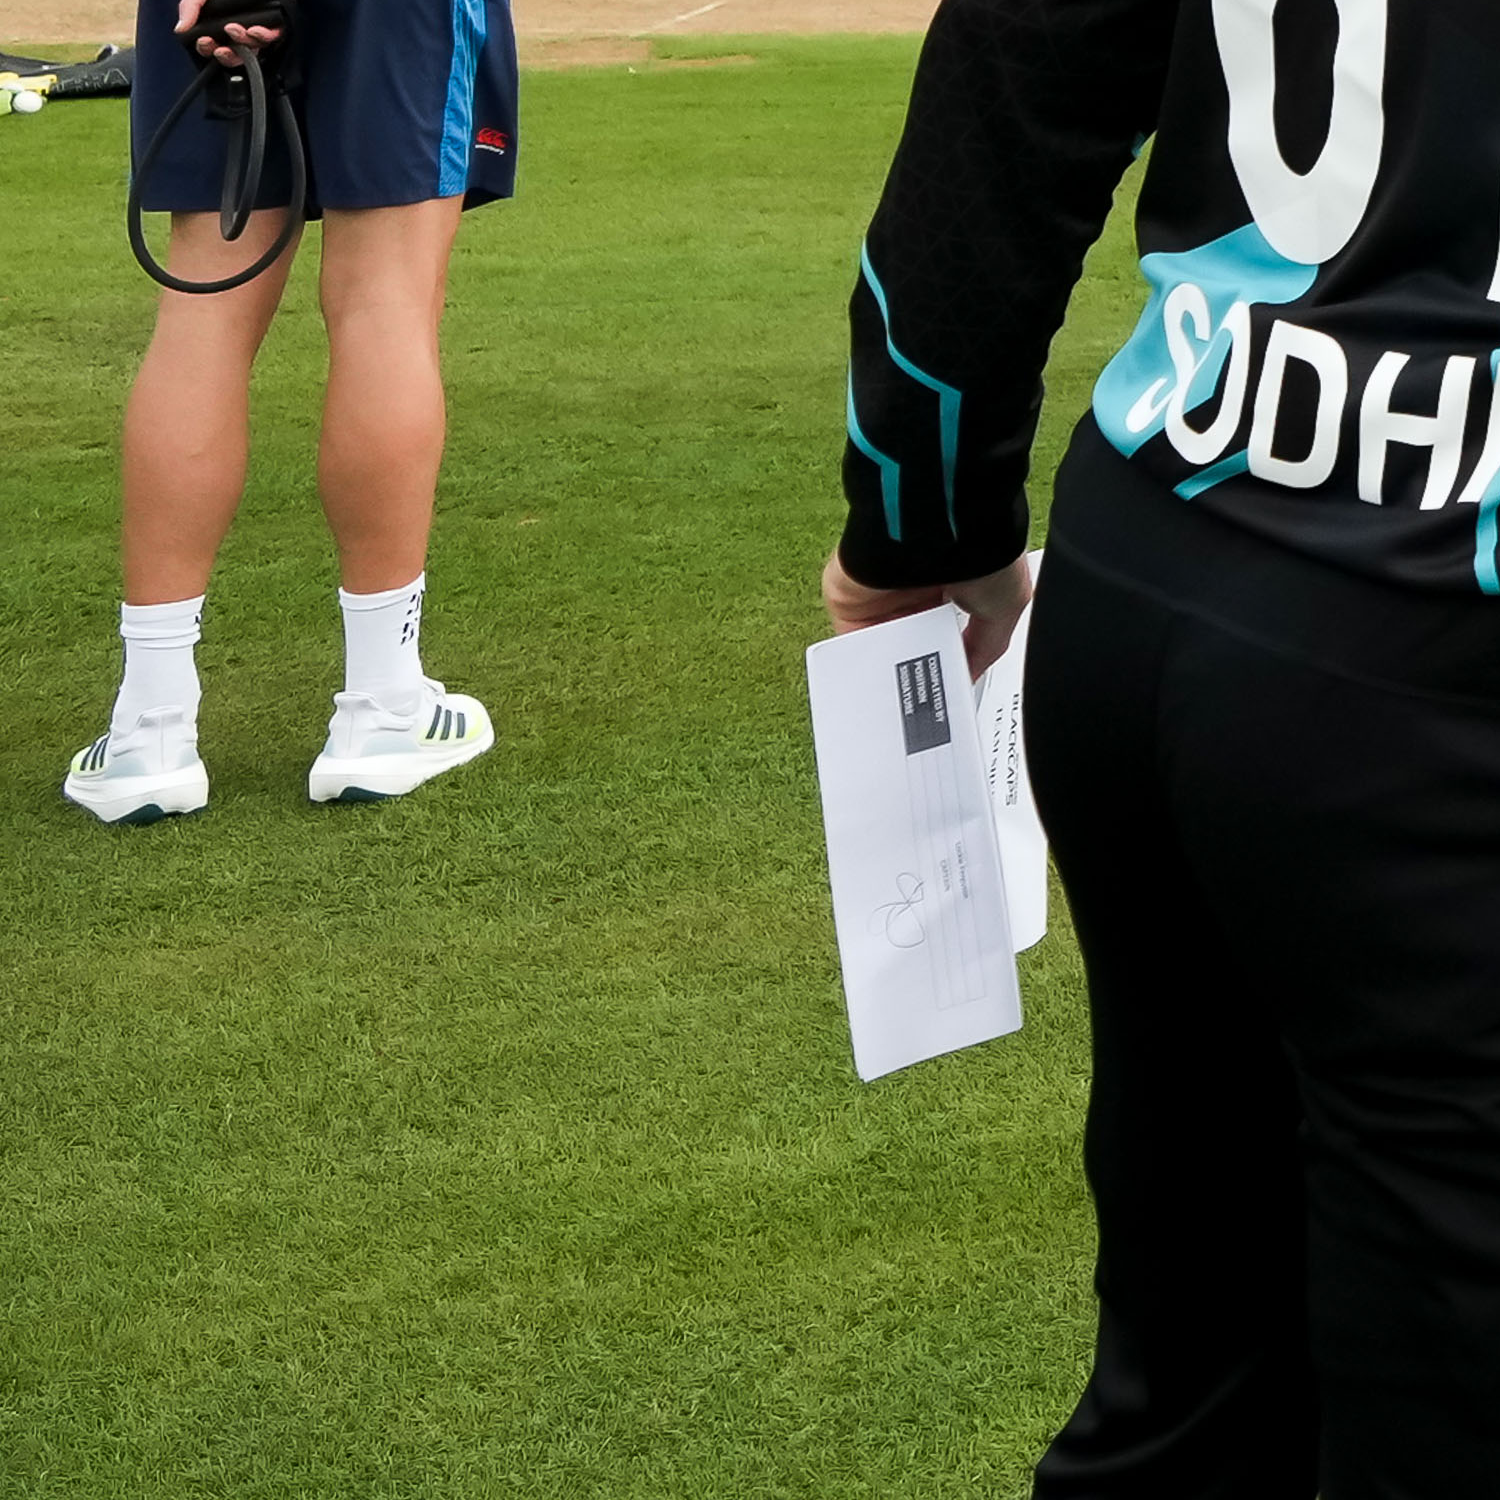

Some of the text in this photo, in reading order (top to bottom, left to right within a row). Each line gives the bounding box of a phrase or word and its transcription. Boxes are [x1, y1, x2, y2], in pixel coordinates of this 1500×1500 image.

[900, 665, 916, 717] SIGNATURE
[913, 660, 928, 704] POSITION
[1003, 693, 1021, 807] BLACKCAPS
